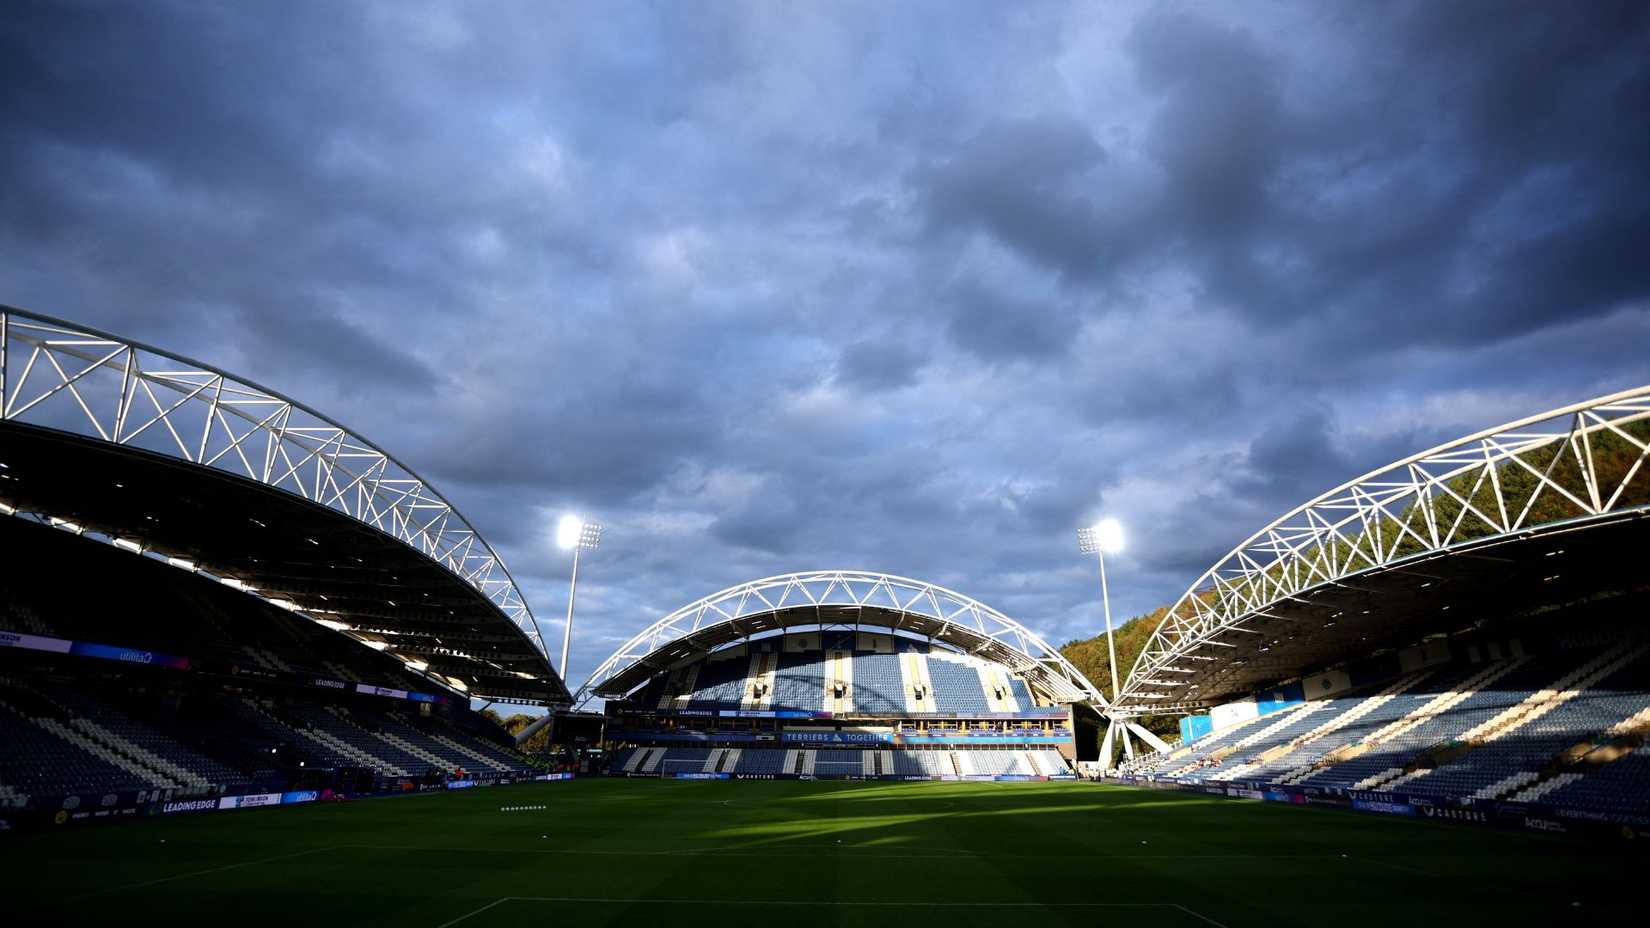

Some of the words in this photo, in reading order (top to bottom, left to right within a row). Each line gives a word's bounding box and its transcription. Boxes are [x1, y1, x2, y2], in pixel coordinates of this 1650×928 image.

[787, 733, 827, 742] TERRIERS
[846, 733, 888, 742] TOGETHER
[163, 801, 197, 813] LEADING
[196, 799, 216, 810] EDGE
